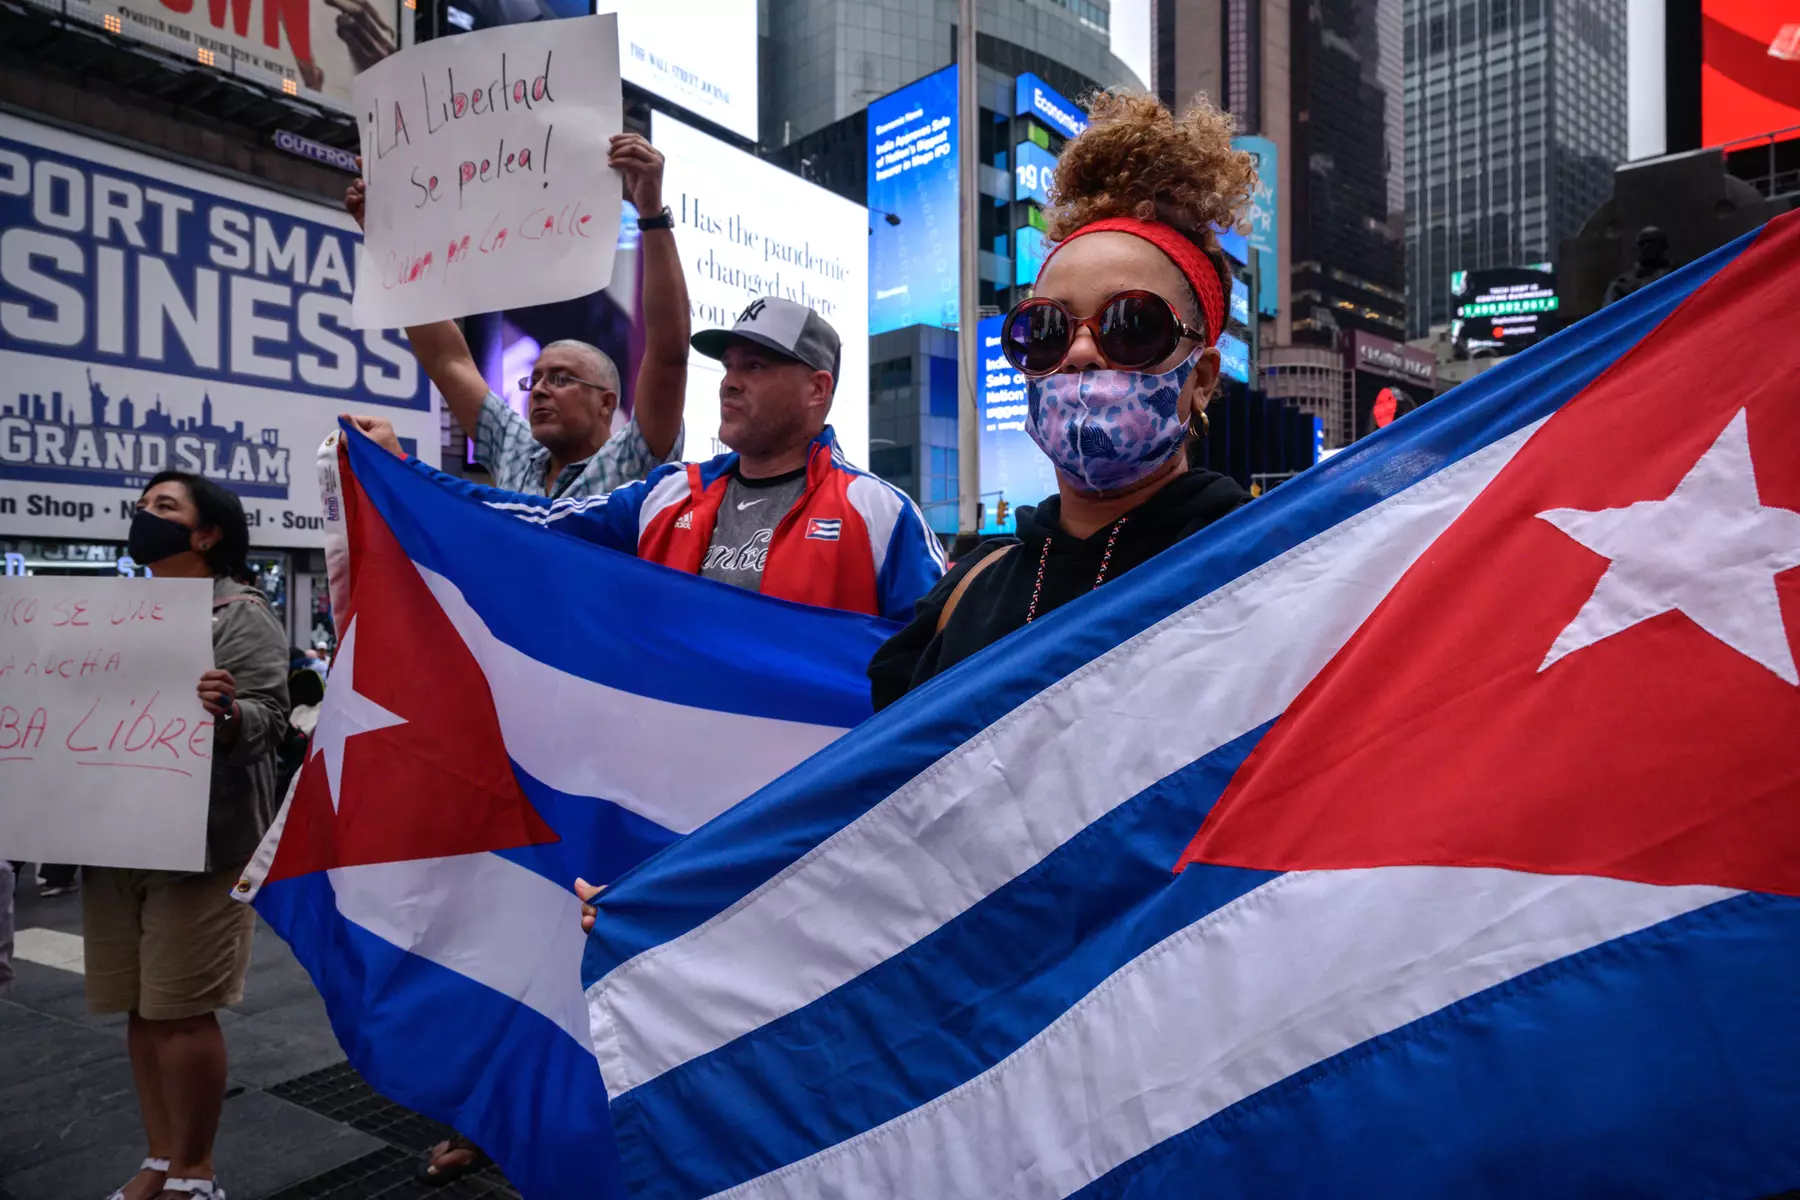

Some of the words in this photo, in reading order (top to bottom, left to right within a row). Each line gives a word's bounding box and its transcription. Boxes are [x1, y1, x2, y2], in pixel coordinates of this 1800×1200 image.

[876, 141, 895, 154] India
[895, 125, 931, 147] Approves
[932, 116, 951, 131] Sale
[1034, 87, 1080, 136] Economic
[935, 143, 950, 157] IPO
[209, 205, 364, 294] SMA
[681, 193, 722, 234] Has
[728, 214, 758, 250] the
[764, 236, 850, 281] pandemic
[697, 248, 780, 298] changed
[0, 228, 419, 399] SINESS
[0, 416, 167, 474] GRAND
[175, 435, 290, 485] SLAM
[27, 494, 94, 522] Shop
